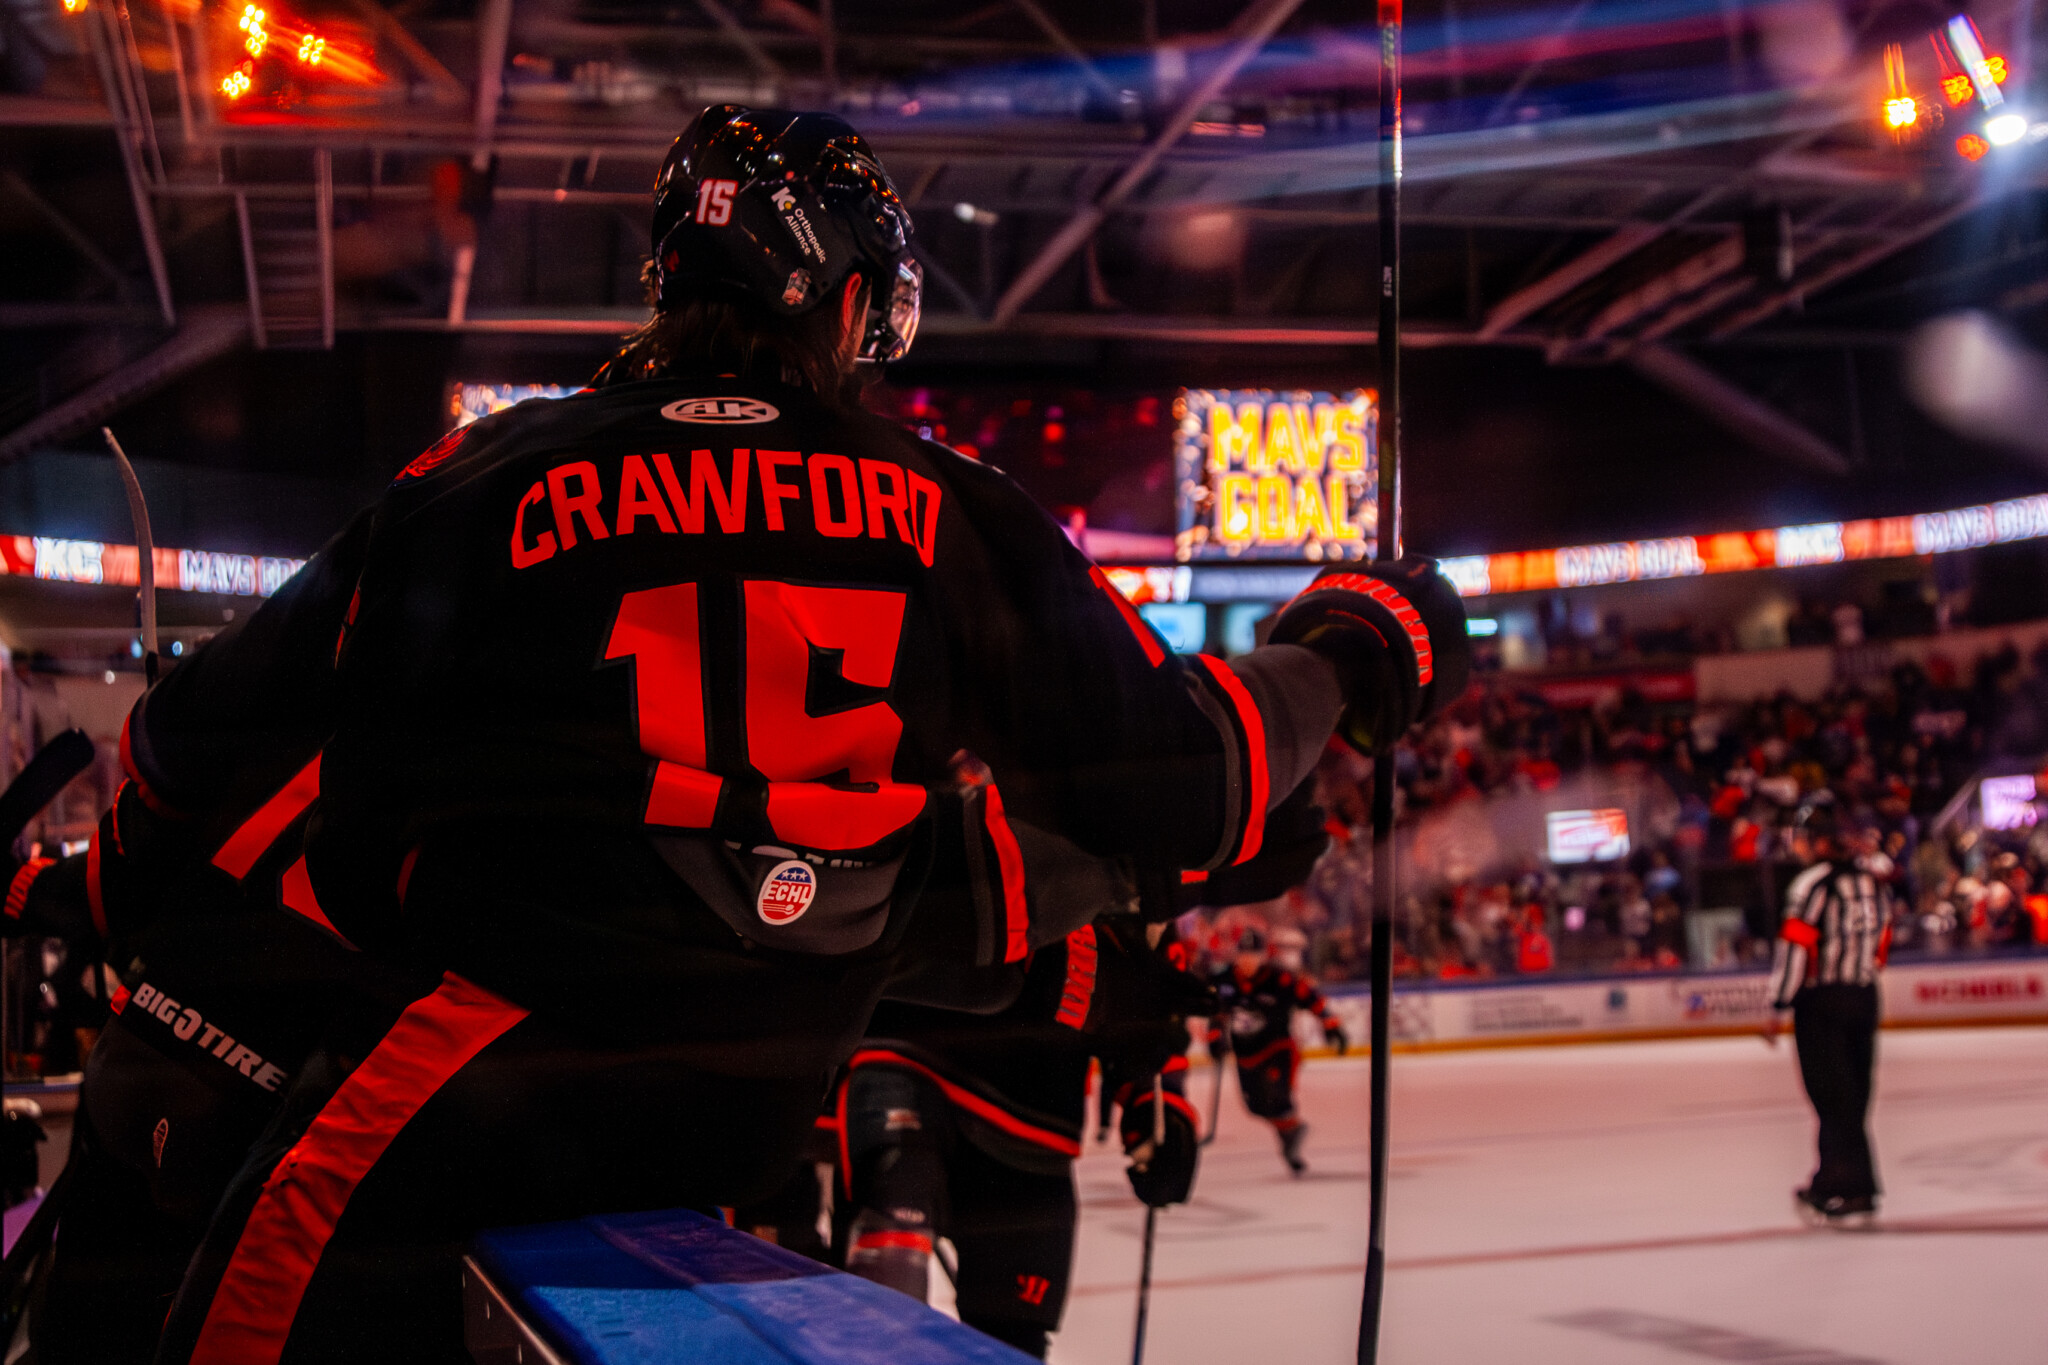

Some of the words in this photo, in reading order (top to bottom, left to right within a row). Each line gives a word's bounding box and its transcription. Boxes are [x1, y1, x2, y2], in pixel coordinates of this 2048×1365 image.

[697, 179, 738, 226] 15
[785, 214, 811, 256] Alliance
[794, 208, 826, 264] Orthopedic
[1207, 402, 1370, 471] MAVS
[511, 448, 942, 570] CRAWFORD
[1215, 472, 1364, 542] GOAL
[1993, 493, 2048, 543] GOA
[604, 580, 927, 851] 15
[763, 881, 812, 905] ECHL
[132, 982, 181, 1024] BIG
[197, 1021, 288, 1092] TIRE
